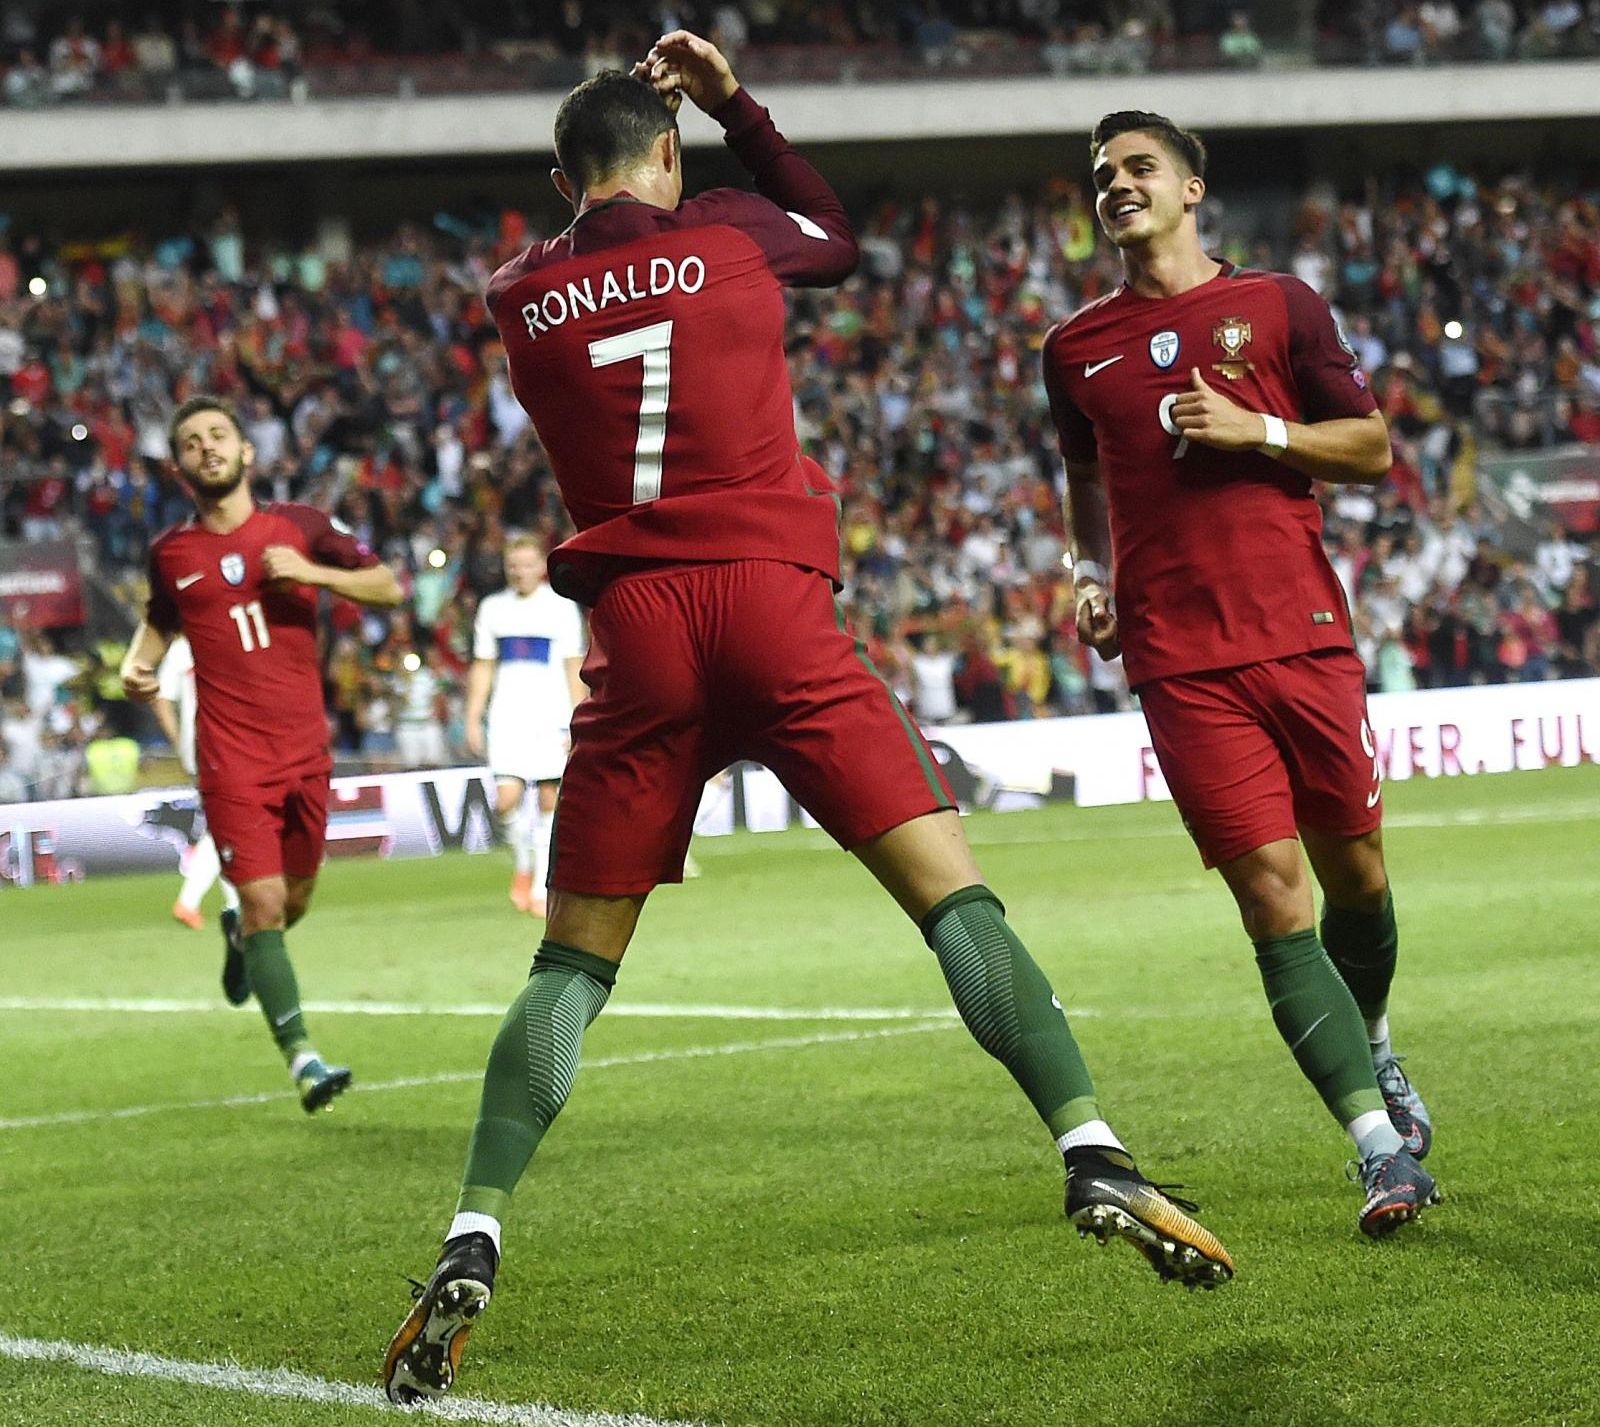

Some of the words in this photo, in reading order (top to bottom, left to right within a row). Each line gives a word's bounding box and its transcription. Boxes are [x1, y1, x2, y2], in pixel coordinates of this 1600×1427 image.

[521, 255, 705, 341] RONALDO
[588, 320, 673, 505] 7
[229, 601, 271, 652] 11
